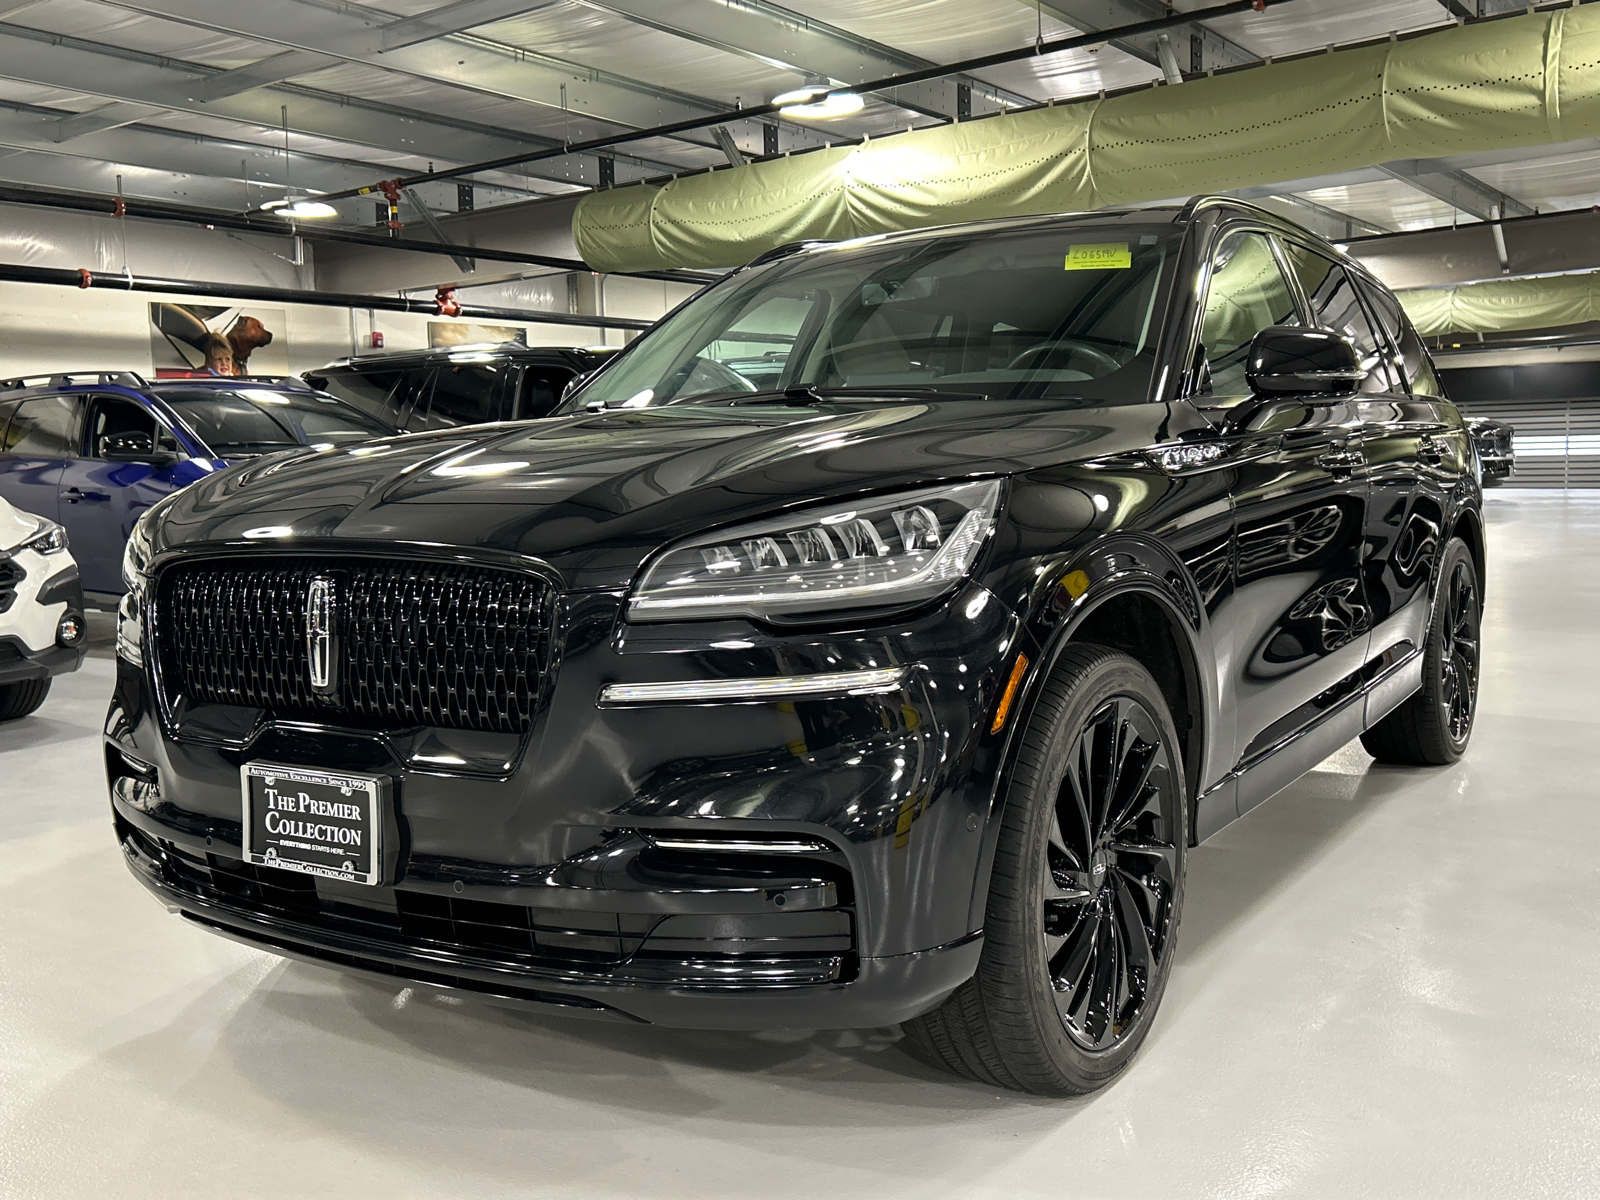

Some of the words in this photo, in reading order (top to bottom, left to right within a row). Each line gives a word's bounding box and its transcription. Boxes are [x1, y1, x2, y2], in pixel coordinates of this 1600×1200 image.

[348, 780, 366, 789] 1995
[264, 788, 297, 812] THE
[297, 792, 362, 820] PREMIER
[265, 811, 362, 846] COLLECTION
[279, 839, 311, 850] EVERYTHING
[311, 844, 330, 853] STARTS
